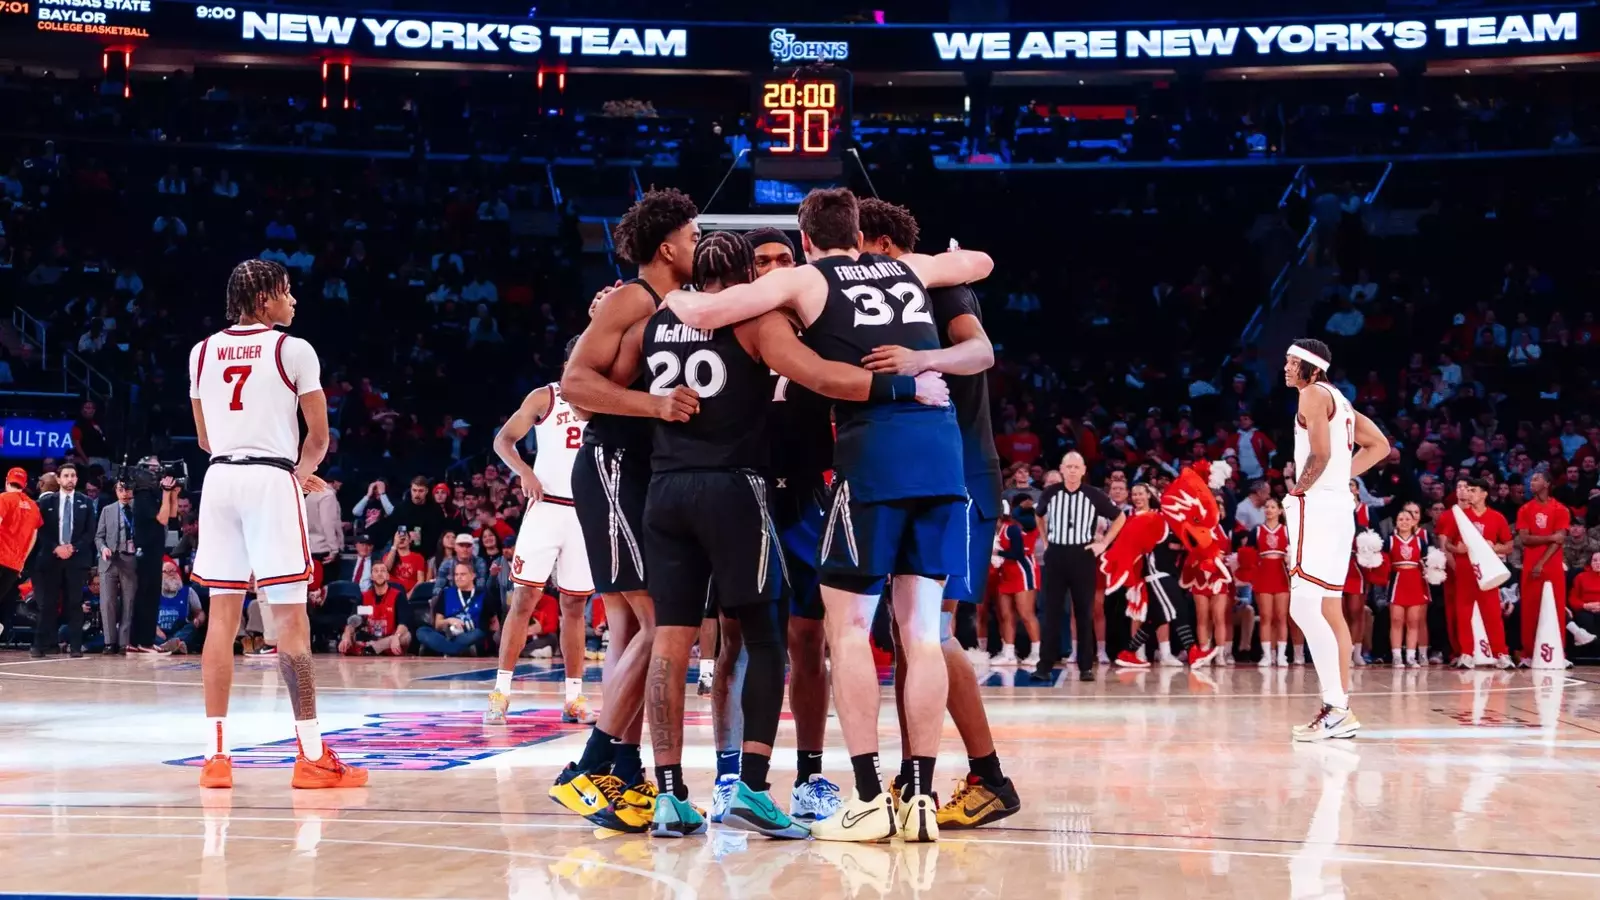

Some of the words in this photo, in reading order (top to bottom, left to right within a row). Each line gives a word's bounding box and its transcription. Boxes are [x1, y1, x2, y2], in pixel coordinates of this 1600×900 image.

[38, 8, 107, 24] BAYLOR
[104, 0, 151, 12] STATE
[196, 6, 236, 20] 9:00
[37, 21, 83, 32] COLLEGE
[85, 24, 150, 37] BASKETBALL
[242, 11, 357, 45] NEW
[362, 18, 542, 52] YORK'S
[550, 26, 687, 57] TEAM
[932, 32, 1011, 60] WE
[1017, 30, 1117, 59] ARE
[1126, 27, 1240, 57] NEW
[1245, 21, 1427, 54] YORK'S
[1435, 12, 1577, 46] TEAM
[764, 83, 836, 108] 20:00
[769, 109, 829, 152] 30
[841, 282, 934, 328] 32
[217, 345, 262, 361] WILCHER
[646, 349, 728, 398] 20
[223, 365, 252, 411] 7
[9, 429, 74, 449] ULTRA
